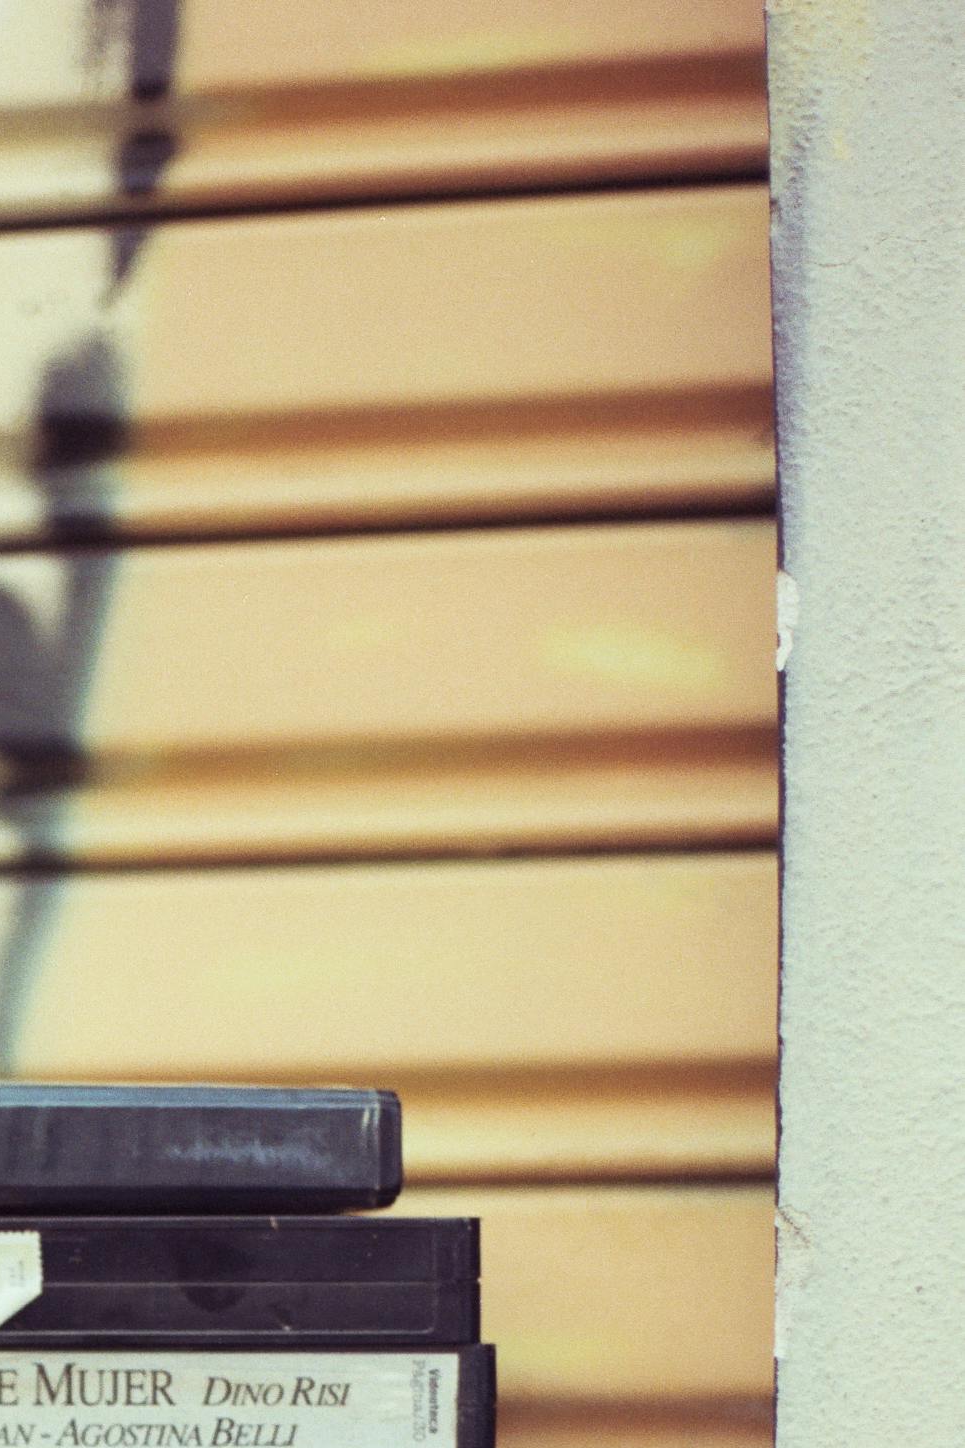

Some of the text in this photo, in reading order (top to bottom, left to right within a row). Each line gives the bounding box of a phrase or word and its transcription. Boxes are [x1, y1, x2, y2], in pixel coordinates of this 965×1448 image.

[33, 1362, 176, 1407] MUJER
[203, 1376, 351, 1407] DINO RISI
[429, 1368, 440, 1435] Videoteca
[55, 1418, 203, 1448] AGOSTINA
[210, 1417, 298, 1447] BELLI
